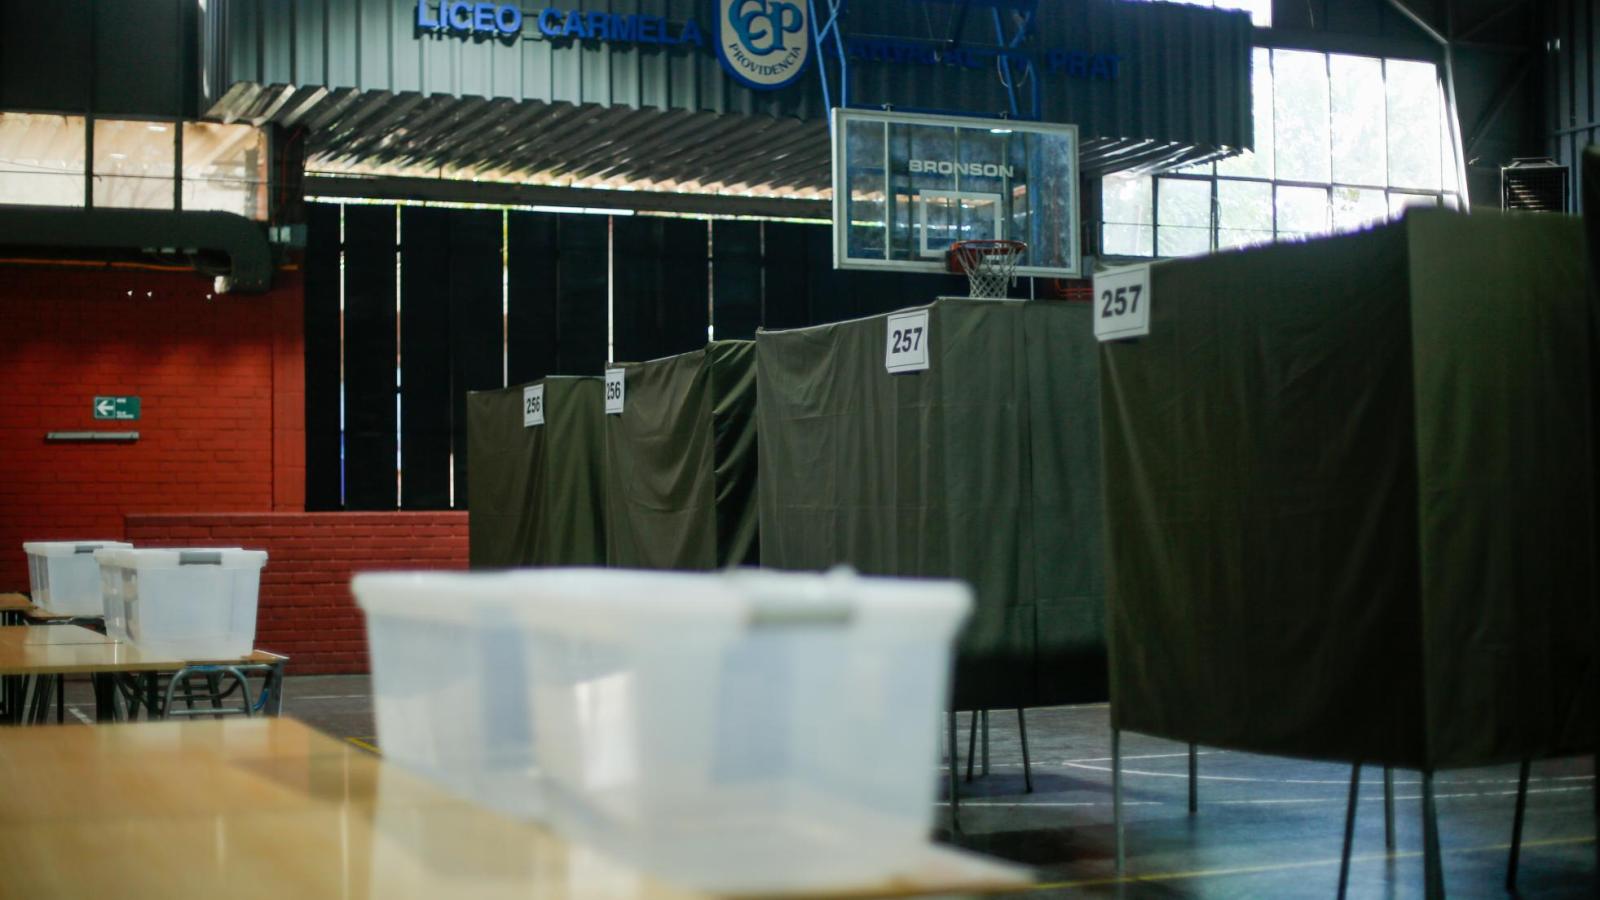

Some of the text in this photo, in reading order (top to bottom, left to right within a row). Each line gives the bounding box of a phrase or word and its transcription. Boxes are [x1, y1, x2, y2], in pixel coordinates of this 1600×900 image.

[418, 0, 701, 45] LICEO CARMELA
[729, 42, 802, 75] PROVIDENCIA
[908, 159, 1014, 177] BRONSON
[1101, 284, 1142, 318] 257
[892, 326, 923, 354] 257
[526, 396, 541, 415] 256
